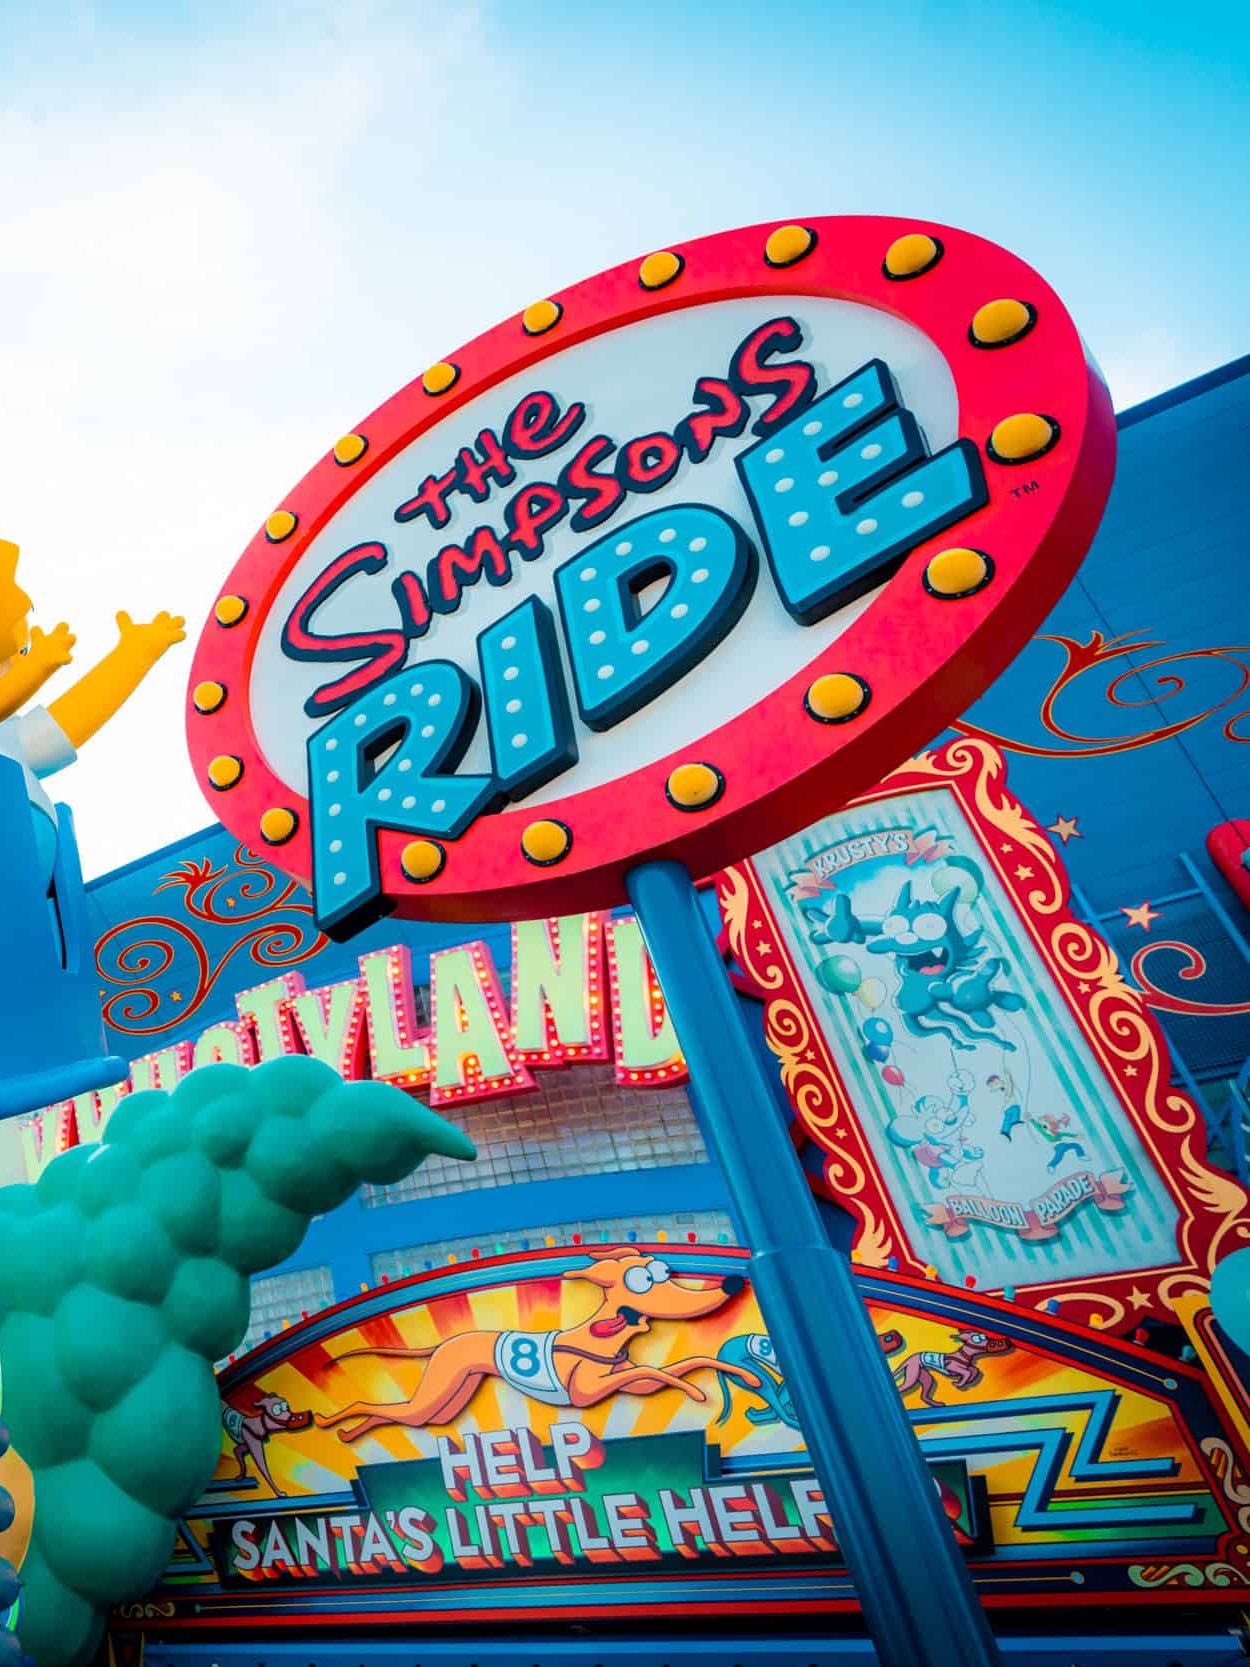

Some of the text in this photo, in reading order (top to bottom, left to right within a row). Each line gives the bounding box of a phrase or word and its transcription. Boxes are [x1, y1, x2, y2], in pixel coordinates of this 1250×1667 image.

[306, 358, 990, 942] RIDE
[812, 832, 910, 878] KRUSTY'S
[20, 910, 690, 1185] TYLAND
[951, 1174, 1095, 1229] BALLOON PARADE
[510, 1337, 541, 1378] 8
[436, 1421, 595, 1494] HELP
[230, 1478, 941, 1570] SANTA'S LITTLE HELP
